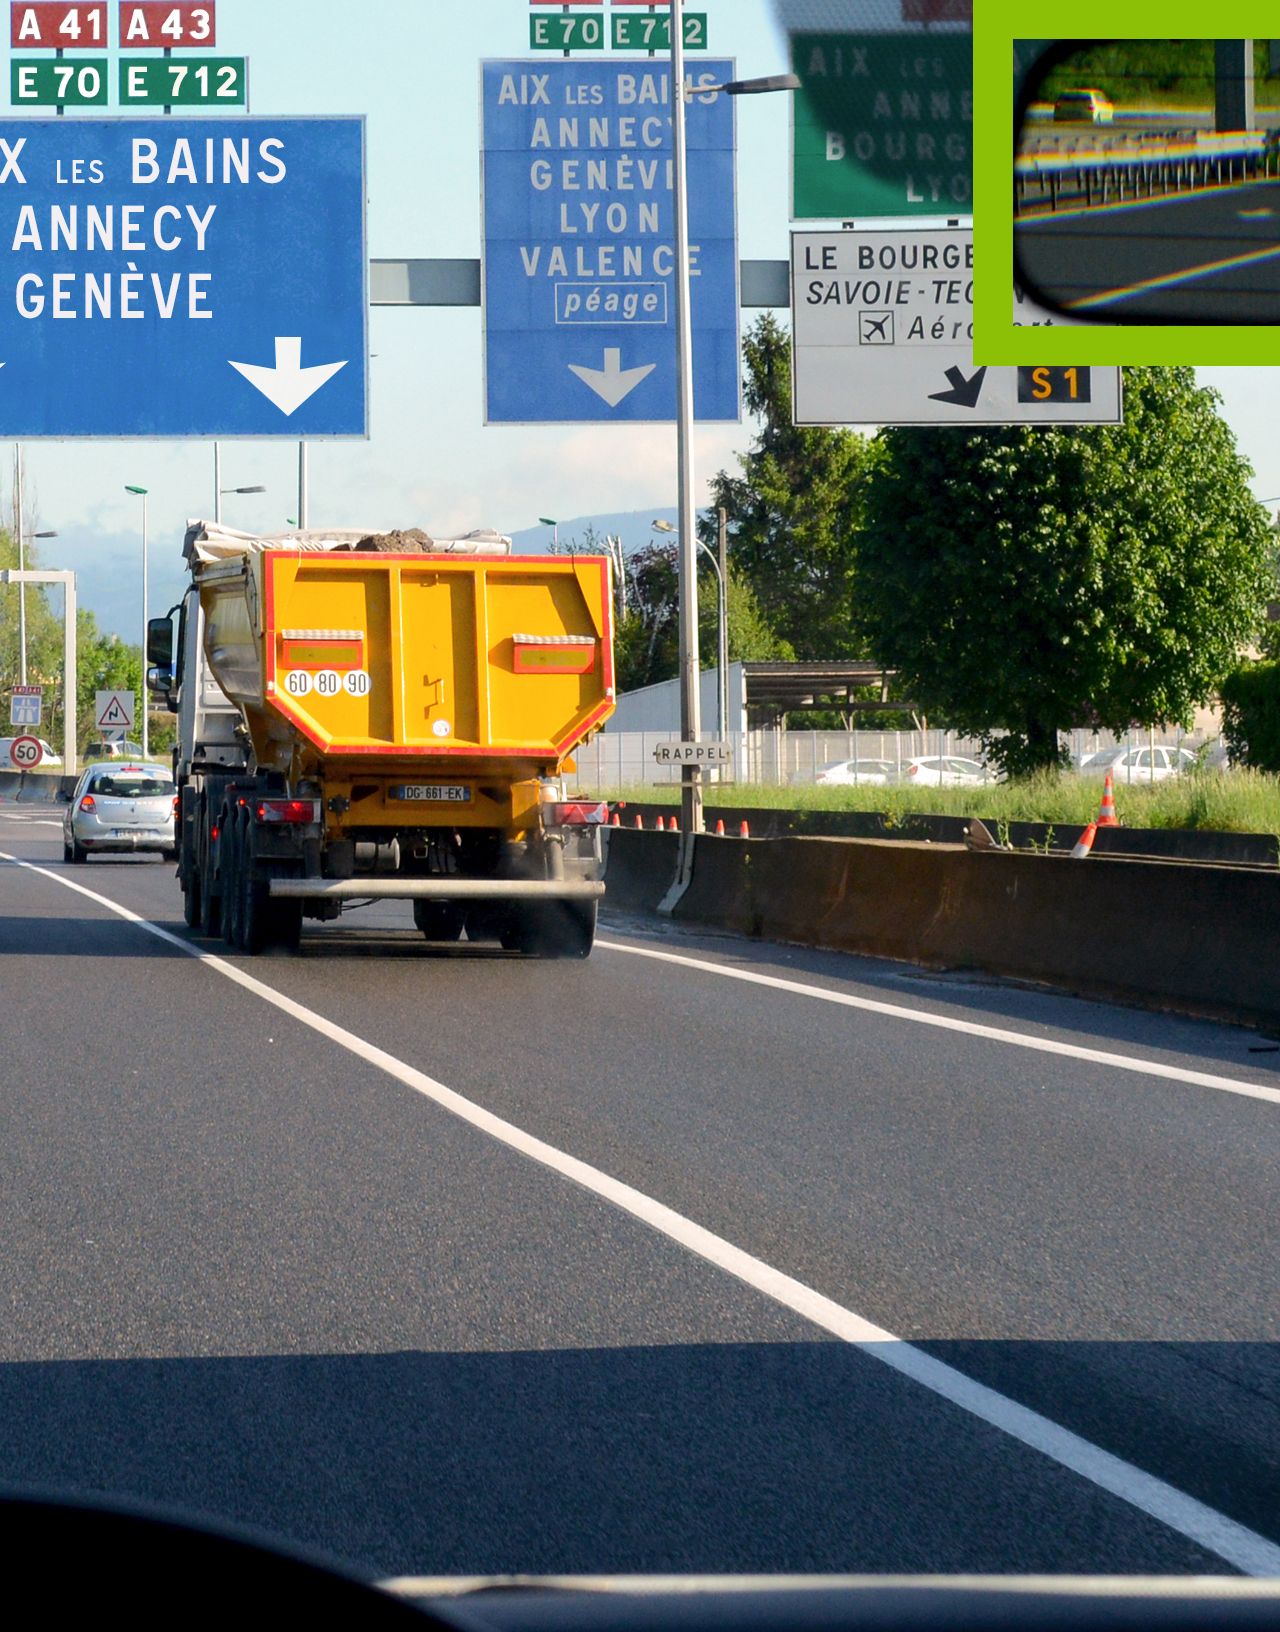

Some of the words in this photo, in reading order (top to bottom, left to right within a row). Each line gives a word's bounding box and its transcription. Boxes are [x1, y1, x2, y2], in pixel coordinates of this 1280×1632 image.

[18, 8, 42, 41] A
[59, 8, 102, 41] 41
[126, 8, 149, 41] A
[161, 8, 211, 41] 43
[535, 18, 549, 44] E
[562, 18, 599, 45] 70
[615, 18, 630, 44] E
[808, 47, 869, 77] AIX
[18, 66, 38, 98] E
[53, 66, 101, 98] 70
[127, 65, 148, 97] E
[168, 65, 239, 98] 712
[498, 74, 551, 105] AIX
[565, 85, 604, 105] LES
[530, 117, 688, 148] ANNEC
[826, 131, 966, 161] BOURG
[56, 159, 105, 184] LES
[131, 137, 287, 185] BAINS
[11, 204, 217, 252] ANNECY
[560, 202, 659, 234] LYON
[520, 245, 701, 277] VALENCE
[805, 246, 838, 270] LE
[15, 262, 214, 320] GENÈVE
[564, 287, 658, 319] péage
[289, 673, 307, 693] 60
[319, 673, 336, 693] 80
[348, 673, 366, 693] 90
[16, 745, 37, 760] 50
[662, 748, 726, 759] RAPPEL
